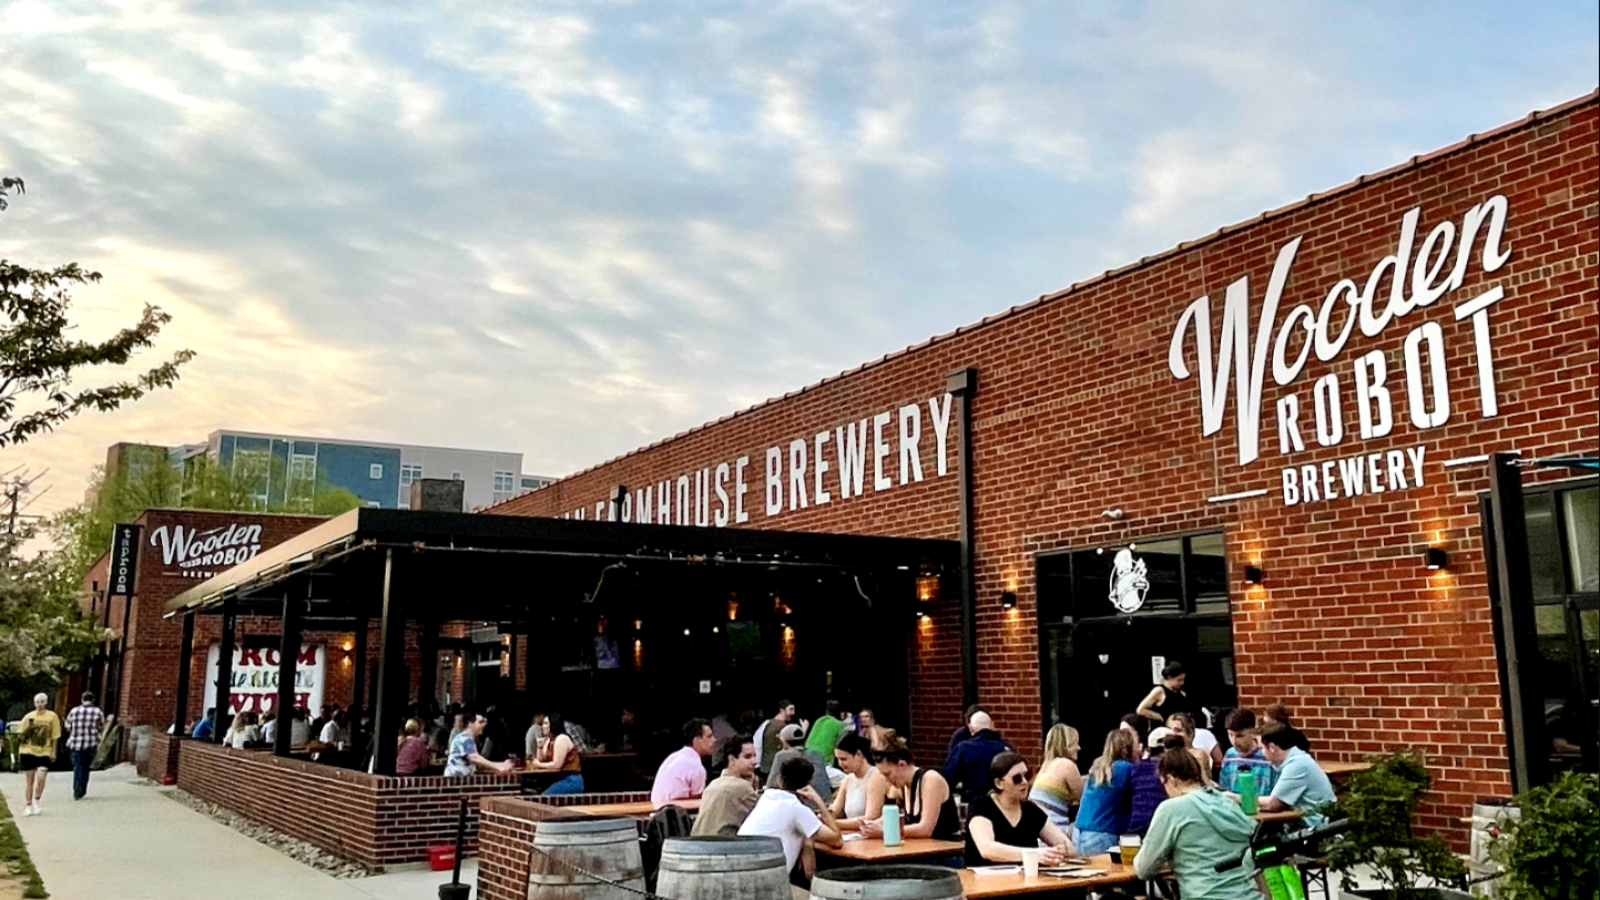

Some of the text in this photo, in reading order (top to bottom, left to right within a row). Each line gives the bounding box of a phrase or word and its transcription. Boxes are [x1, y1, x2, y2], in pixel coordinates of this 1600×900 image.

[1168, 194, 1511, 466] Wooden
[1276, 285, 1504, 455] ROBOT
[595, 393, 953, 528] MHOUSE BREWERY
[1282, 446, 1426, 506] BREWERY
[116, 528, 131, 593] taproom
[150, 523, 262, 565] Wooden
[202, 544, 261, 566] ROBOT
[214, 670, 314, 688] HARLOTE
[216, 643, 317, 666] ROM
